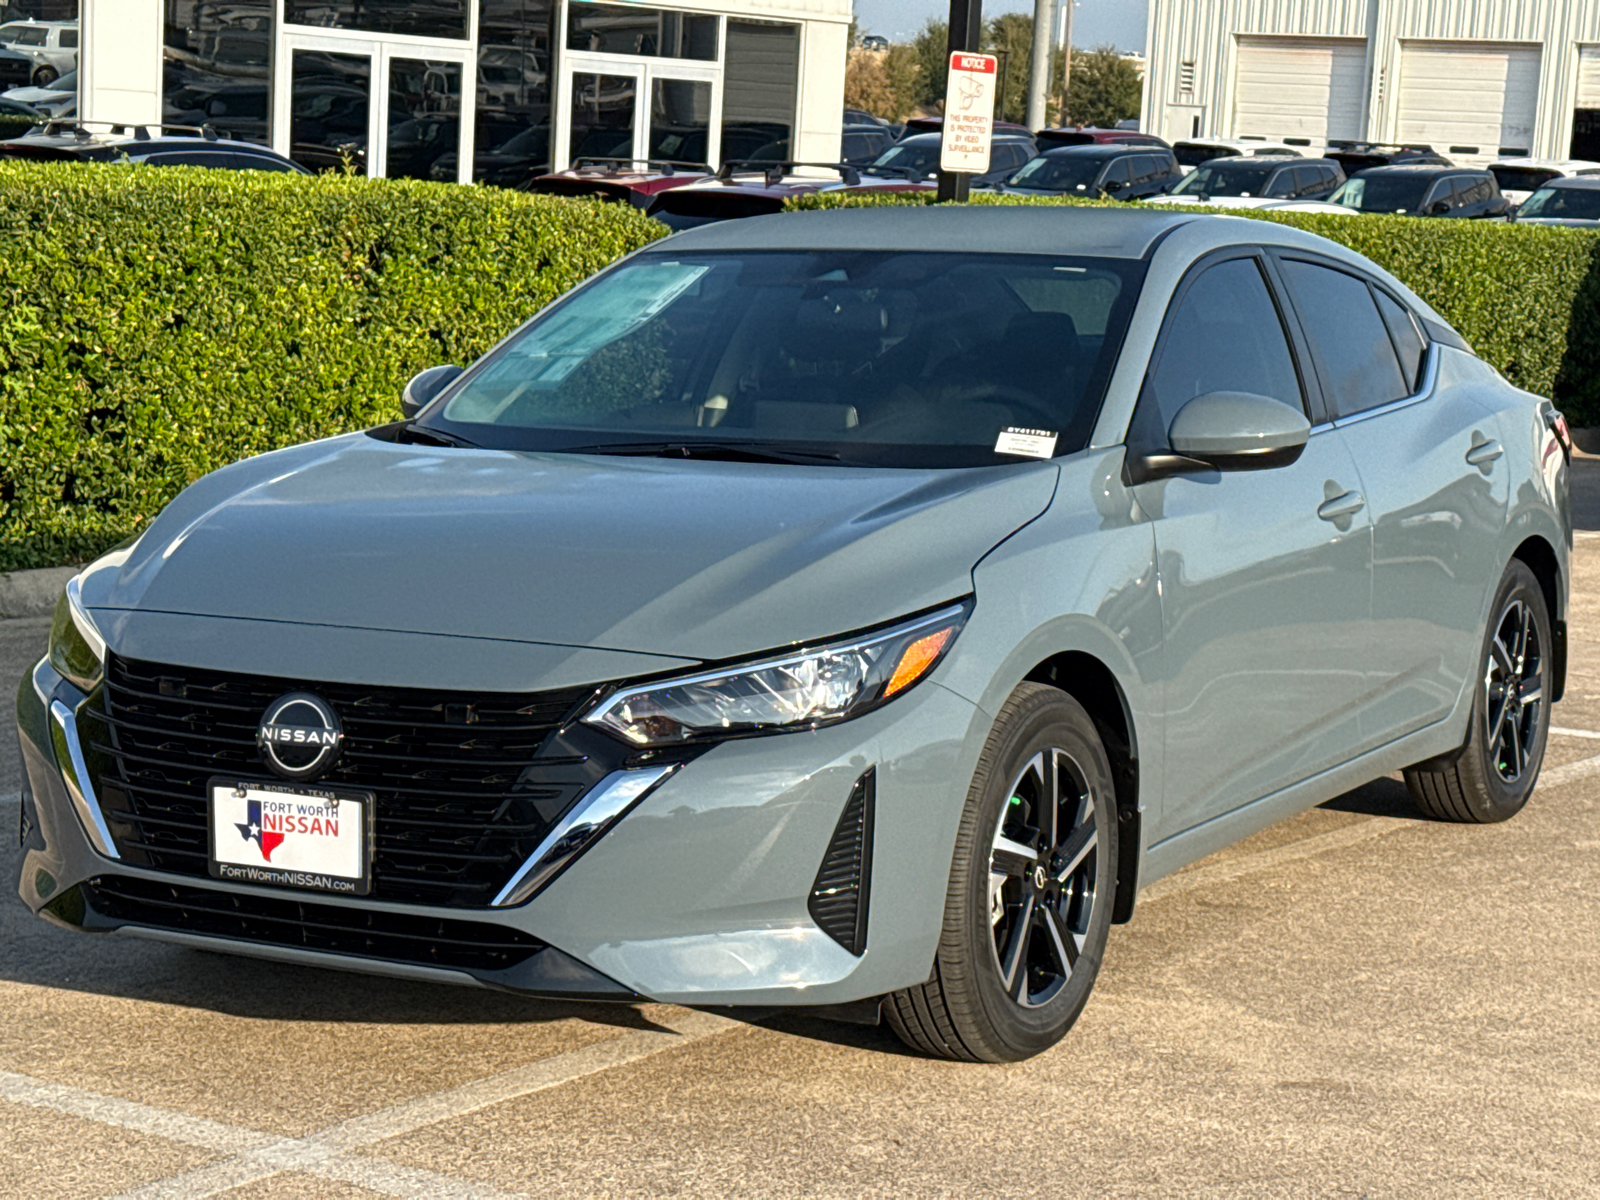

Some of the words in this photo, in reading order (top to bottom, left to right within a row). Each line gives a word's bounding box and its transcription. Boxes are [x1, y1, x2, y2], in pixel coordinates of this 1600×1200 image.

[961, 57, 985, 69] NOTICE
[950, 113, 961, 122] THIS
[962, 115, 988, 124] PROPERTY
[957, 125, 986, 134] PROTECTED
[955, 134, 962, 142] BY
[964, 135, 979, 144] VIDEO
[948, 143, 985, 154] SURVEILLANCE
[262, 726, 336, 744] NISSAN
[237, 782, 260, 791] FORT
[263, 784, 295, 794] WORTH
[307, 789, 336, 799] TEXAS
[263, 801, 293, 814] FORT
[297, 804, 339, 819] WORTH
[263, 813, 339, 837] NISSAN
